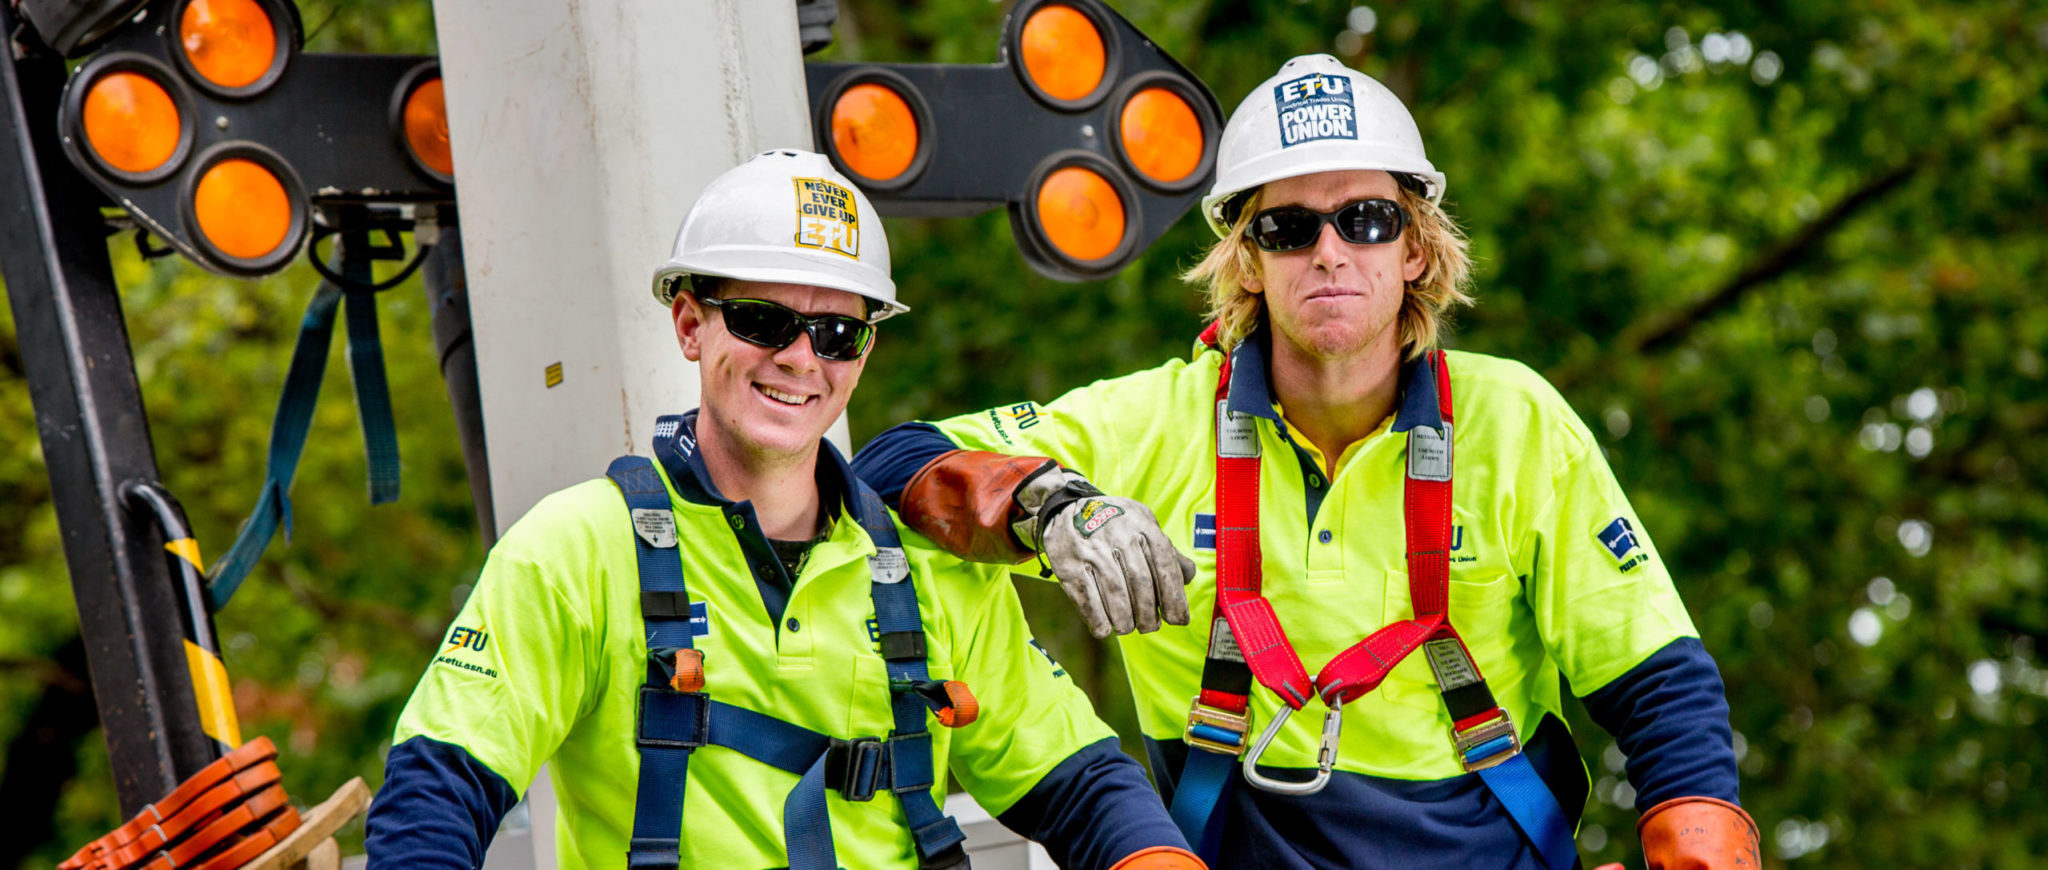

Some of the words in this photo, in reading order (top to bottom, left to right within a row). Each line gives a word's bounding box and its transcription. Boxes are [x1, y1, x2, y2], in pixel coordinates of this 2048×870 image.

[1282, 77, 1344, 103] ETU
[1281, 104, 1353, 129] POWER
[1284, 119, 1354, 144] UNION.
[804, 181, 849, 200] NEVER
[811, 192, 847, 210] EVER
[802, 203, 837, 219] GIVE
[839, 209, 857, 224] UP
[800, 216, 858, 256] ETU
[1011, 402, 1040, 430] ETU
[448, 626, 489, 652] ETU
